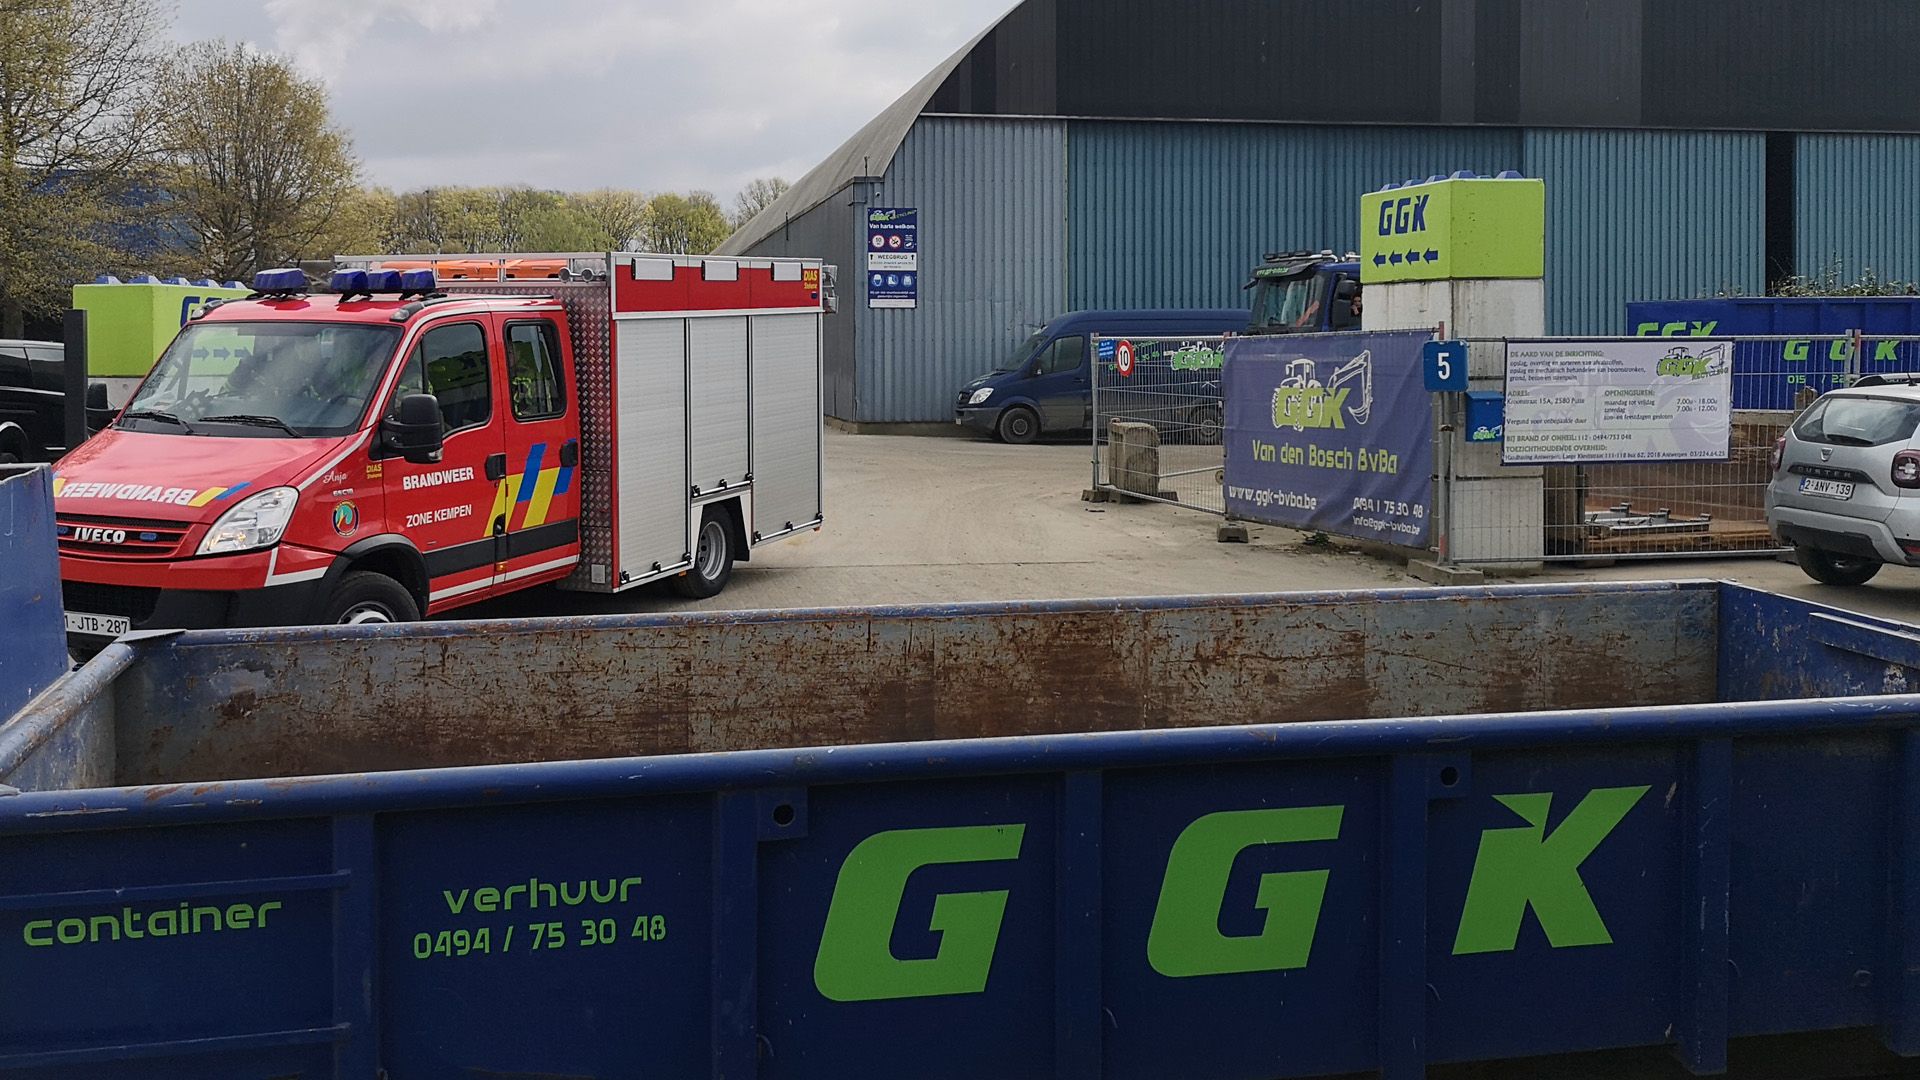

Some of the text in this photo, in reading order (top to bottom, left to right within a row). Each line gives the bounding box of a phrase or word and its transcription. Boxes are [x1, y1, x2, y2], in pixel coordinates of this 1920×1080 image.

[1378, 194, 1430, 236] GGK
[803, 270, 818, 281] DIAS
[1119, 350, 1129, 367] 10
[1438, 352, 1451, 380] 5
[1657, 356, 1714, 377] GGK
[1787, 375, 1807, 384] 015
[1275, 387, 1351, 429] GGK
[1252, 439, 1398, 474] Van den Bosch BvBa
[323, 470, 348, 485] Anja
[366, 463, 382, 473] DIAS
[403, 466, 475, 490] BRANDWEER
[1228, 485, 1317, 510] www.ggk-bvba.be
[1804, 479, 1851, 495] 2-ANV-139
[405, 503, 472, 528] ZONE KEMPEN
[1383, 500, 1395, 515] 75
[1396, 502, 1409, 516] 30
[1412, 503, 1424, 519] 48
[74, 527, 126, 544] IVECO
[64, 614, 128, 635] 1-JTB-287
[443, 877, 642, 914] verhuur
[23, 900, 282, 946] container
[413, 914, 667, 959] 0494 / 75 30 48
